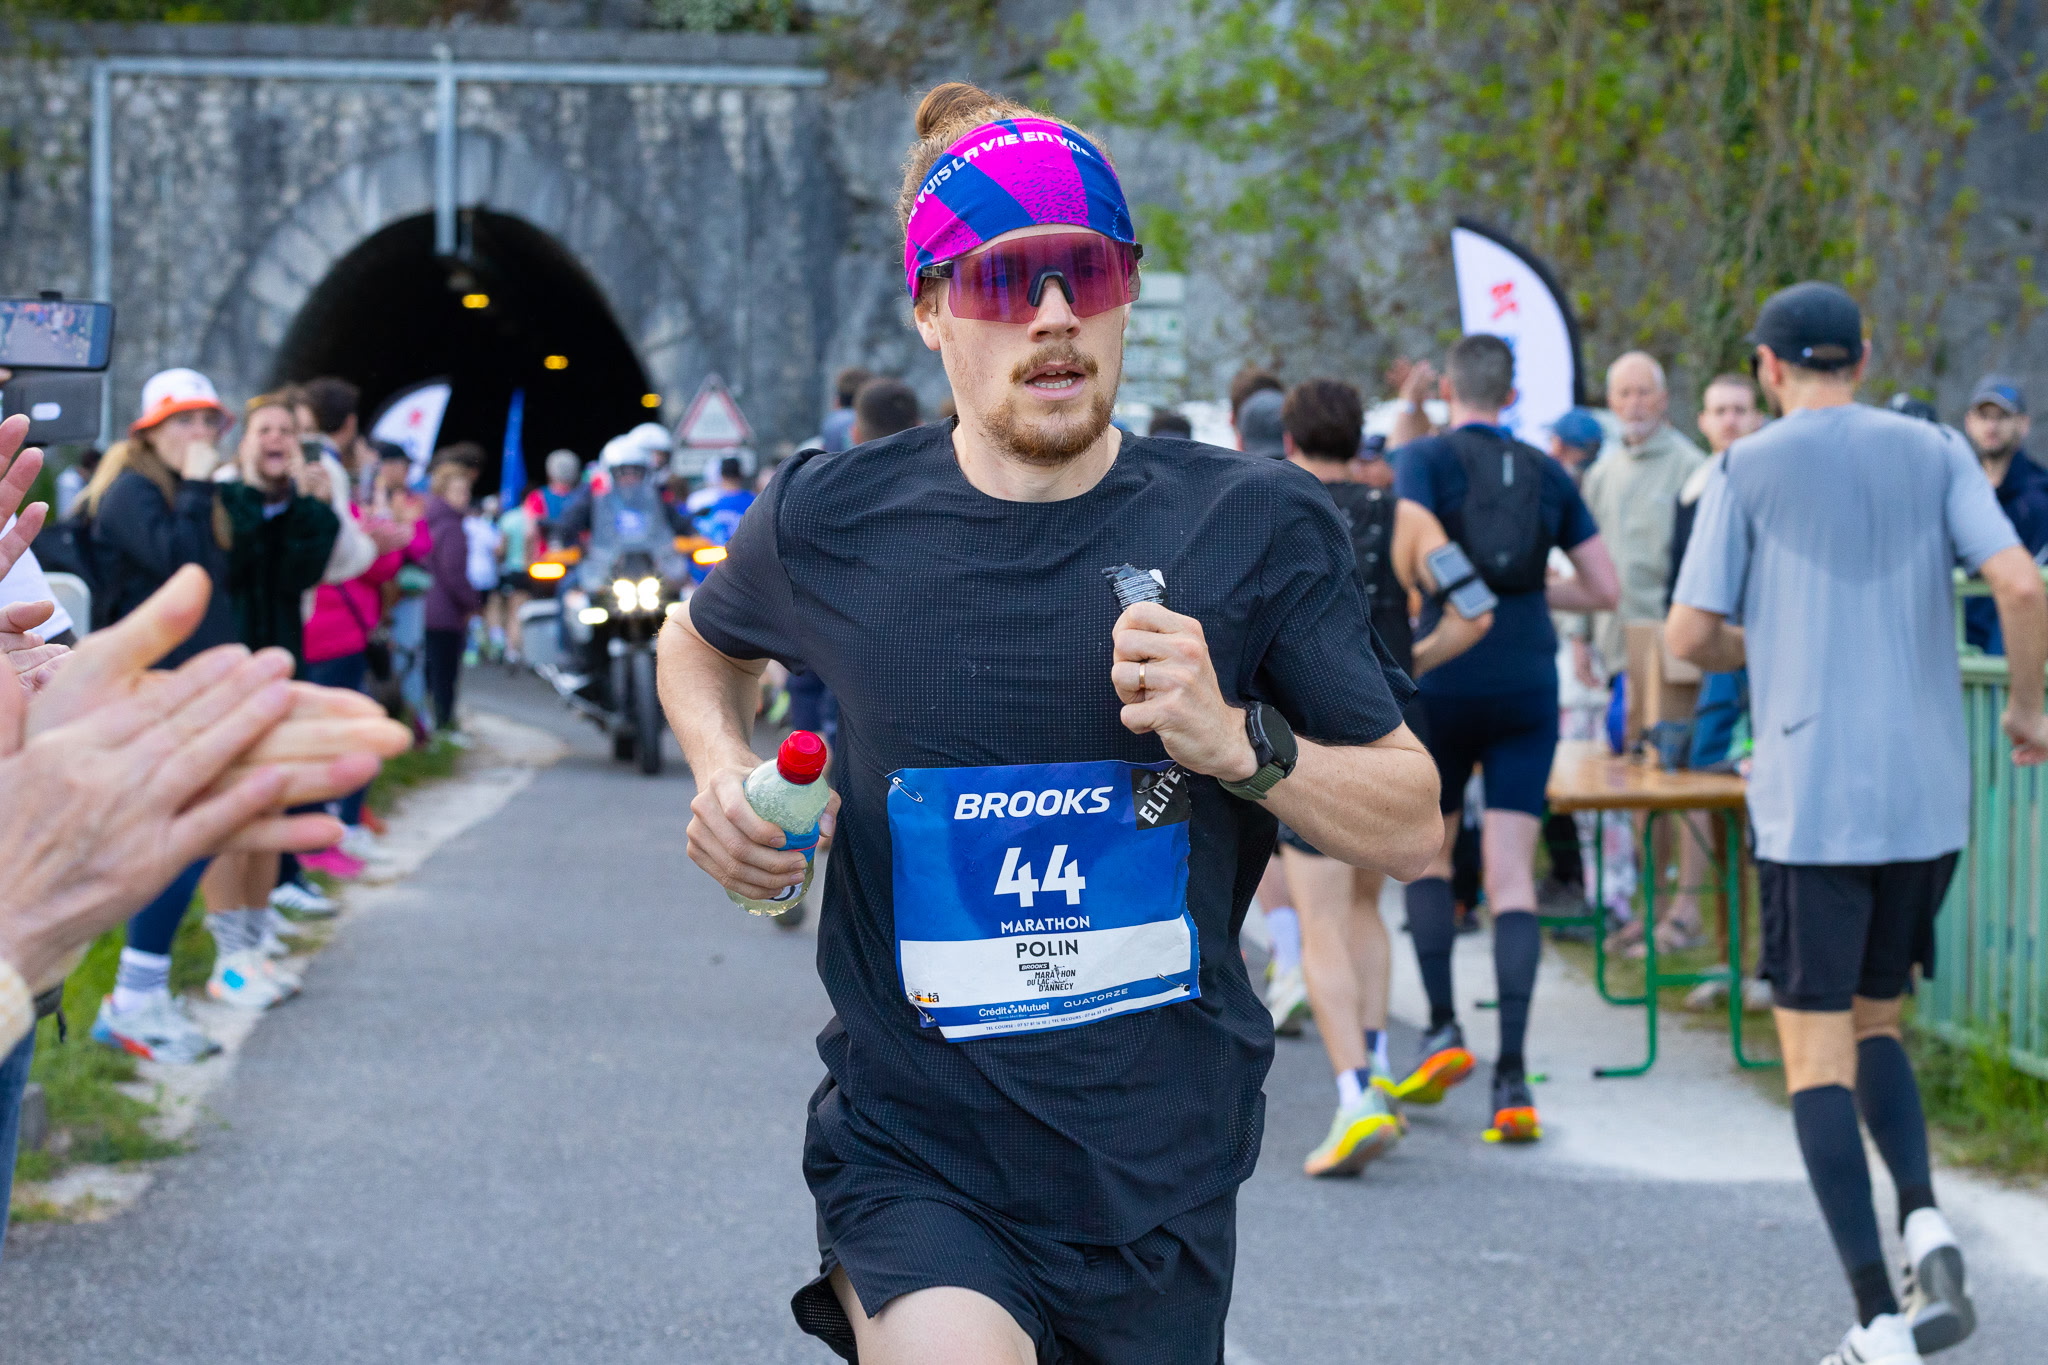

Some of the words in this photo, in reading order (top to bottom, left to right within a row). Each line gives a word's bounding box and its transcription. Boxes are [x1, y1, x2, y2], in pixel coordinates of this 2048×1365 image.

[951, 147, 979, 171] LA
[979, 133, 1020, 152] VIE
[1022, 131, 1054, 143] EN
[953, 786, 1114, 820] BROOKS
[1139, 770, 1181, 825] ELITE
[993, 844, 1086, 908] 44
[1000, 915, 1090, 934] MARATHON
[1016, 939, 1079, 958] POLIN
[1021, 963, 1048, 971] BROOKS
[1037, 978, 1050, 986] LAC
[1038, 982, 1074, 992] D'ANNECY
[1063, 988, 1129, 1008] QUATORZE
[979, 1005, 1008, 1017] Crédit
[1018, 1002, 1050, 1014] Mutuel
